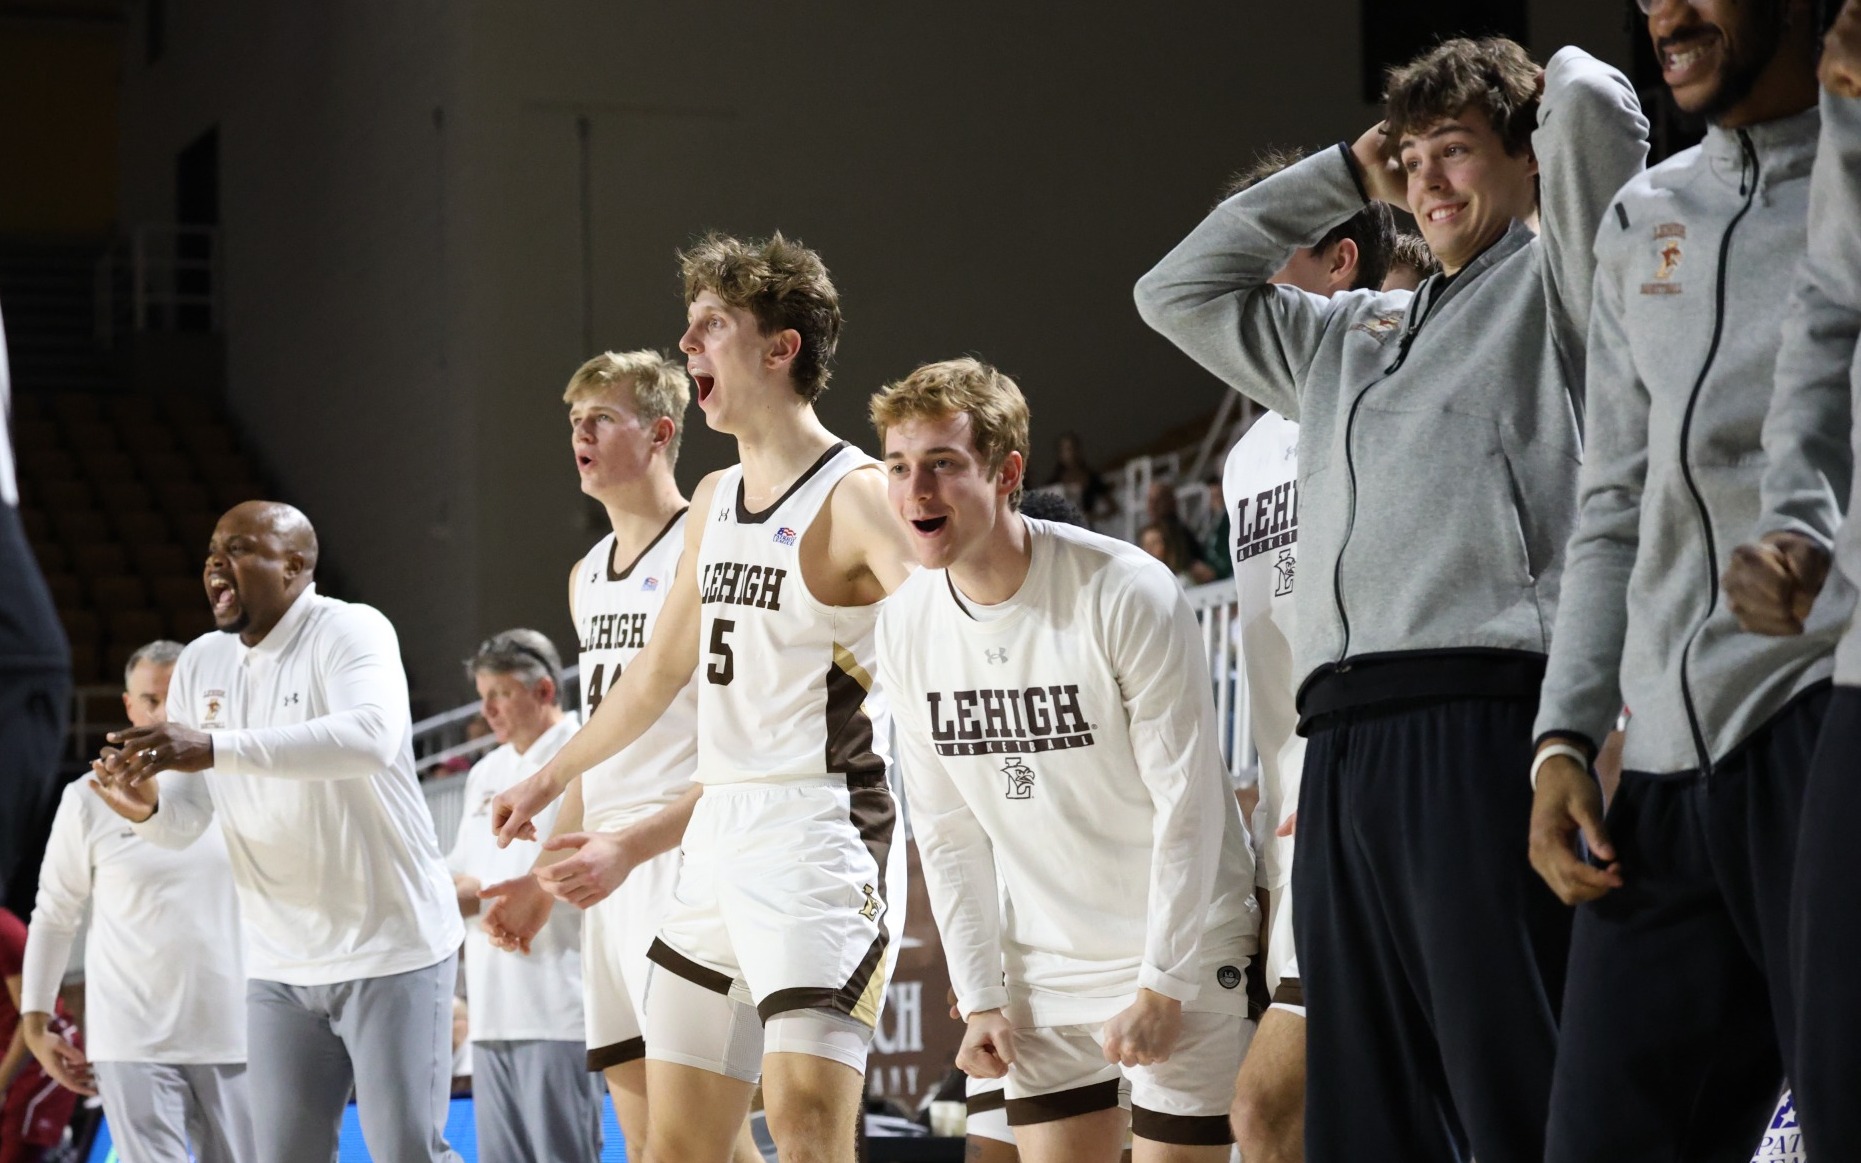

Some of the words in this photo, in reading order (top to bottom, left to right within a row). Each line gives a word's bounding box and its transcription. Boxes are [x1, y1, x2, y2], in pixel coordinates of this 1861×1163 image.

[702, 562, 787, 611] LEHIGH
[707, 618, 735, 686] 5
[927, 684, 1090, 741] LEHIGH
[935, 733, 1095, 756] BASKETBALL
[869, 981, 924, 1054] CH
